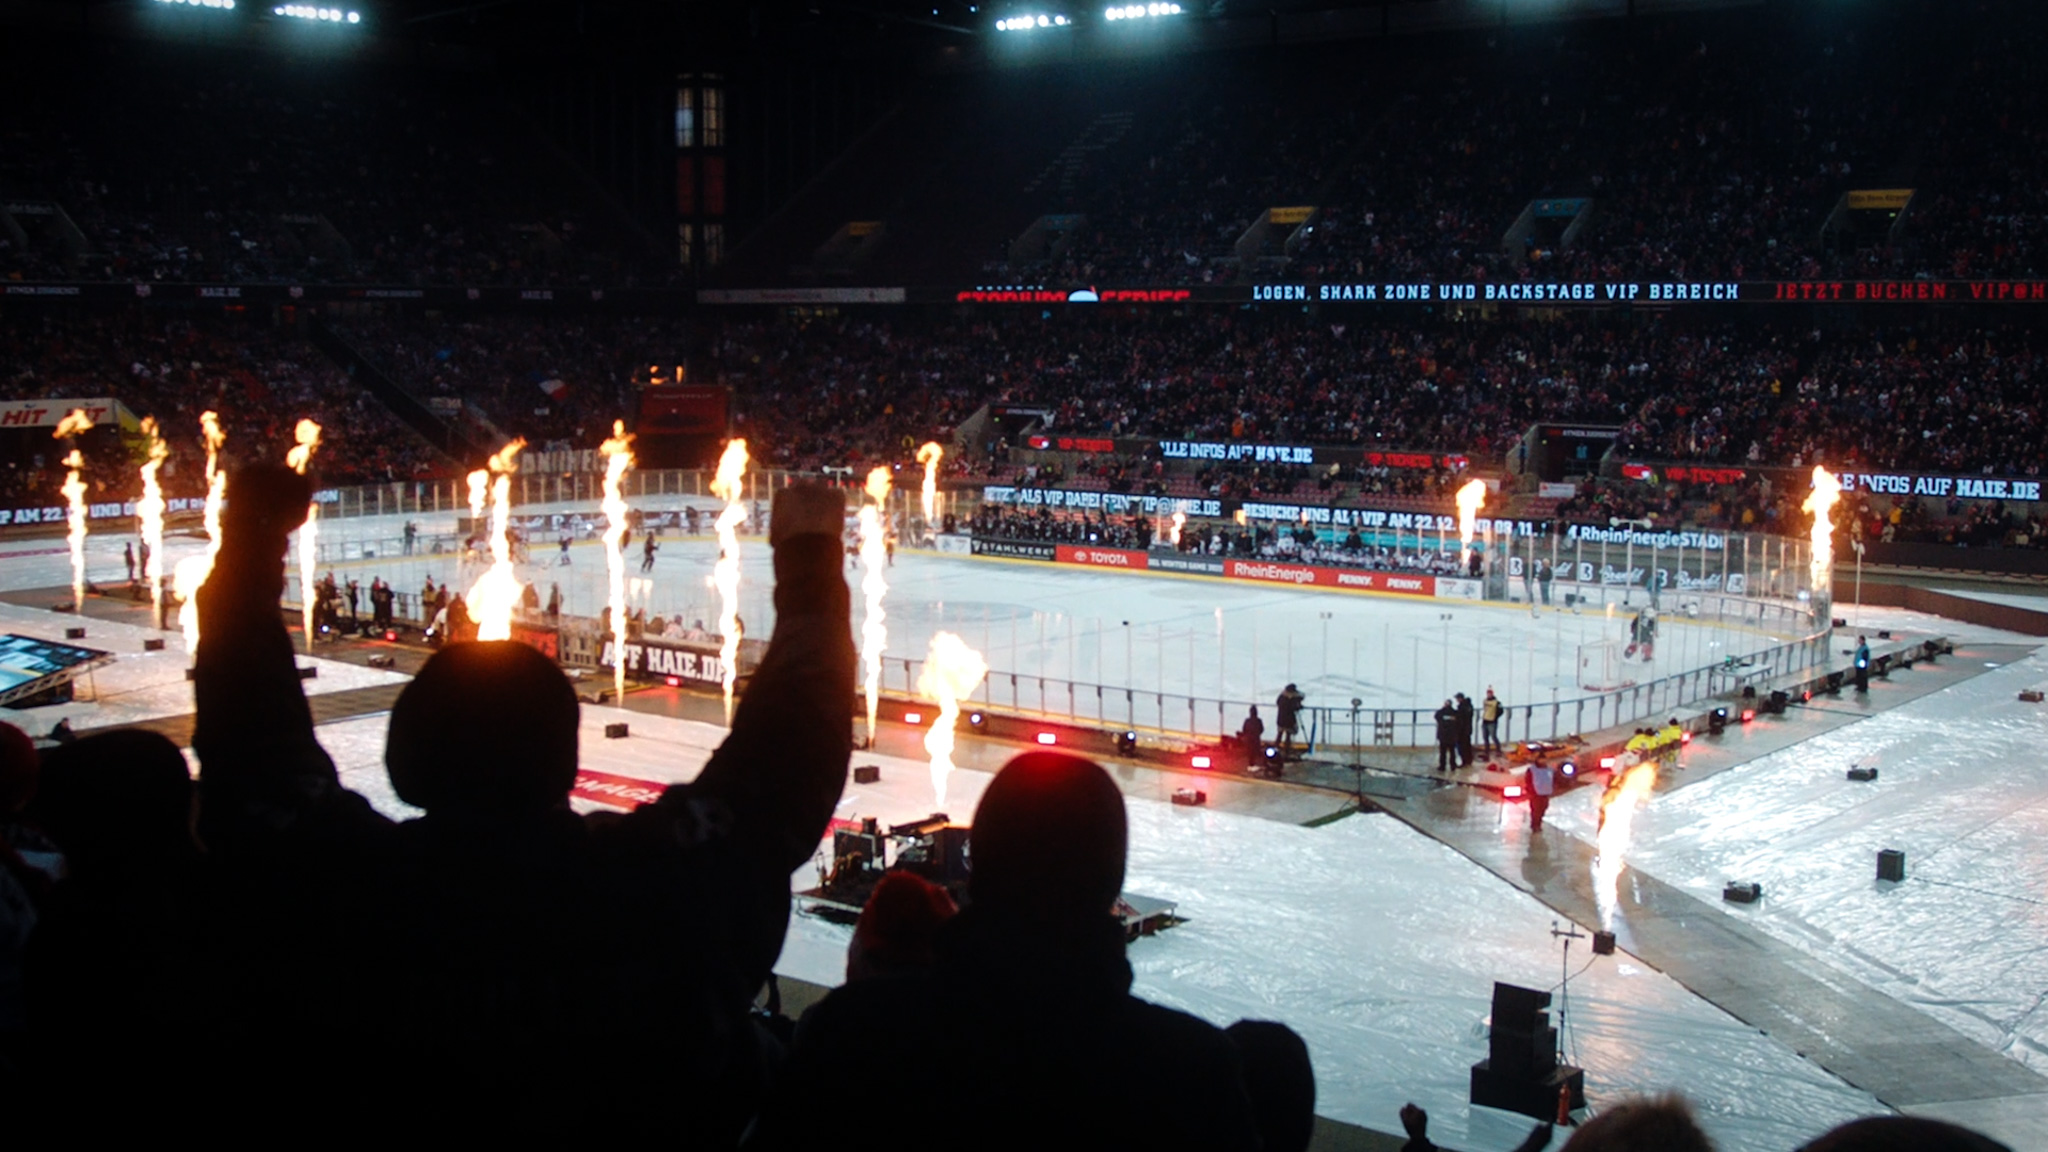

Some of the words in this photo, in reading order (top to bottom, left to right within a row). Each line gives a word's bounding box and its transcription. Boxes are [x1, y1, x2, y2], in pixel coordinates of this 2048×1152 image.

[1253, 285, 1311, 301] LOGEN,
[1320, 285, 1377, 300] SHARK
[1385, 284, 1431, 300] ZONE
[1439, 284, 1476, 300] UND
[1485, 283, 1595, 300] BACKSTAGE
[1605, 283, 1639, 299] VIP
[1650, 283, 1739, 299] BEREICH
[1775, 283, 1843, 299] JETZT
[2, 409, 48, 426] HIT
[1190, 442, 1226, 460] INFOS
[1020, 488, 1042, 504] ALS
[1043, 489, 1064, 506] VIP
[1065, 491, 1100, 508] DABEI
[1914, 477, 1952, 496] AUF
[1956, 479, 2040, 500] HAIE.DE
[14, 508, 41, 523] AM
[90, 500, 121, 518] UND
[1242, 502, 1300, 520] BESUCHE
[1301, 506, 1330, 523] UNS
[1361, 511, 1387, 527] VIP
[1388, 513, 1412, 528] AM
[1090, 552, 1128, 565] TOYOTA
[1234, 562, 1315, 583] RheinEnergie
[601, 641, 642, 669] AF
